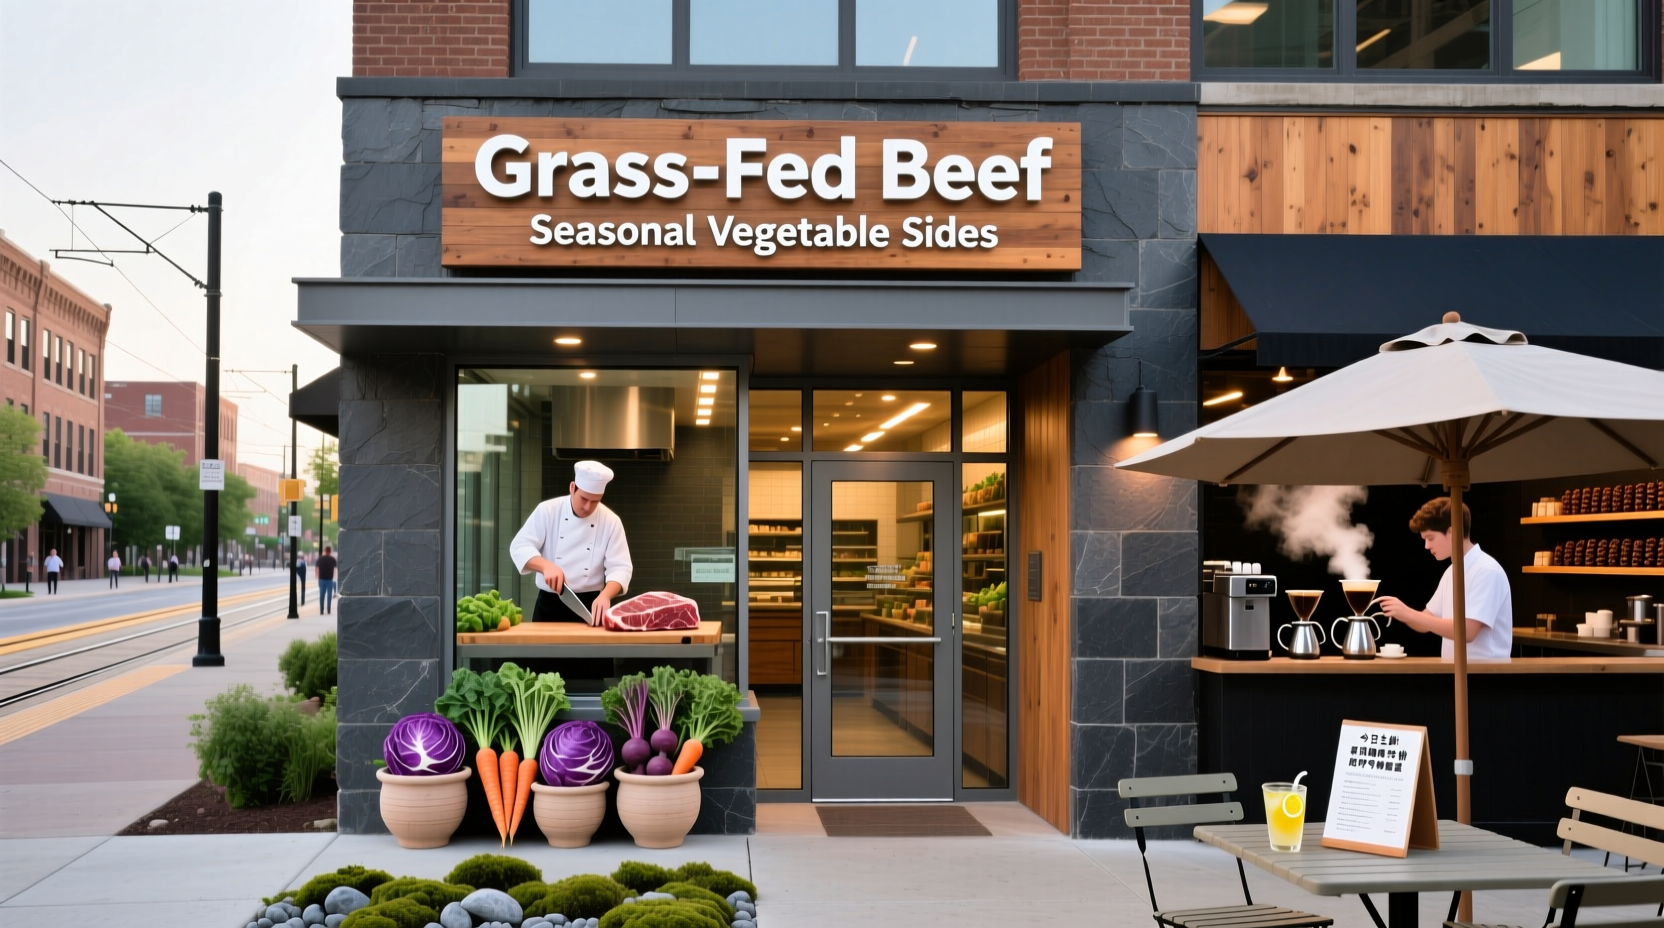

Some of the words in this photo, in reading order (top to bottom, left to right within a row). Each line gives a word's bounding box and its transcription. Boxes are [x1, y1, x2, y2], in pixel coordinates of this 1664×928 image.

[474, 134, 856, 200] Grass-Fed
[882, 137, 1054, 201] Beef
[529, 213, 697, 246] Seasonal
[706, 214, 890, 256] Vegetable
[901, 215, 999, 248] Sides
